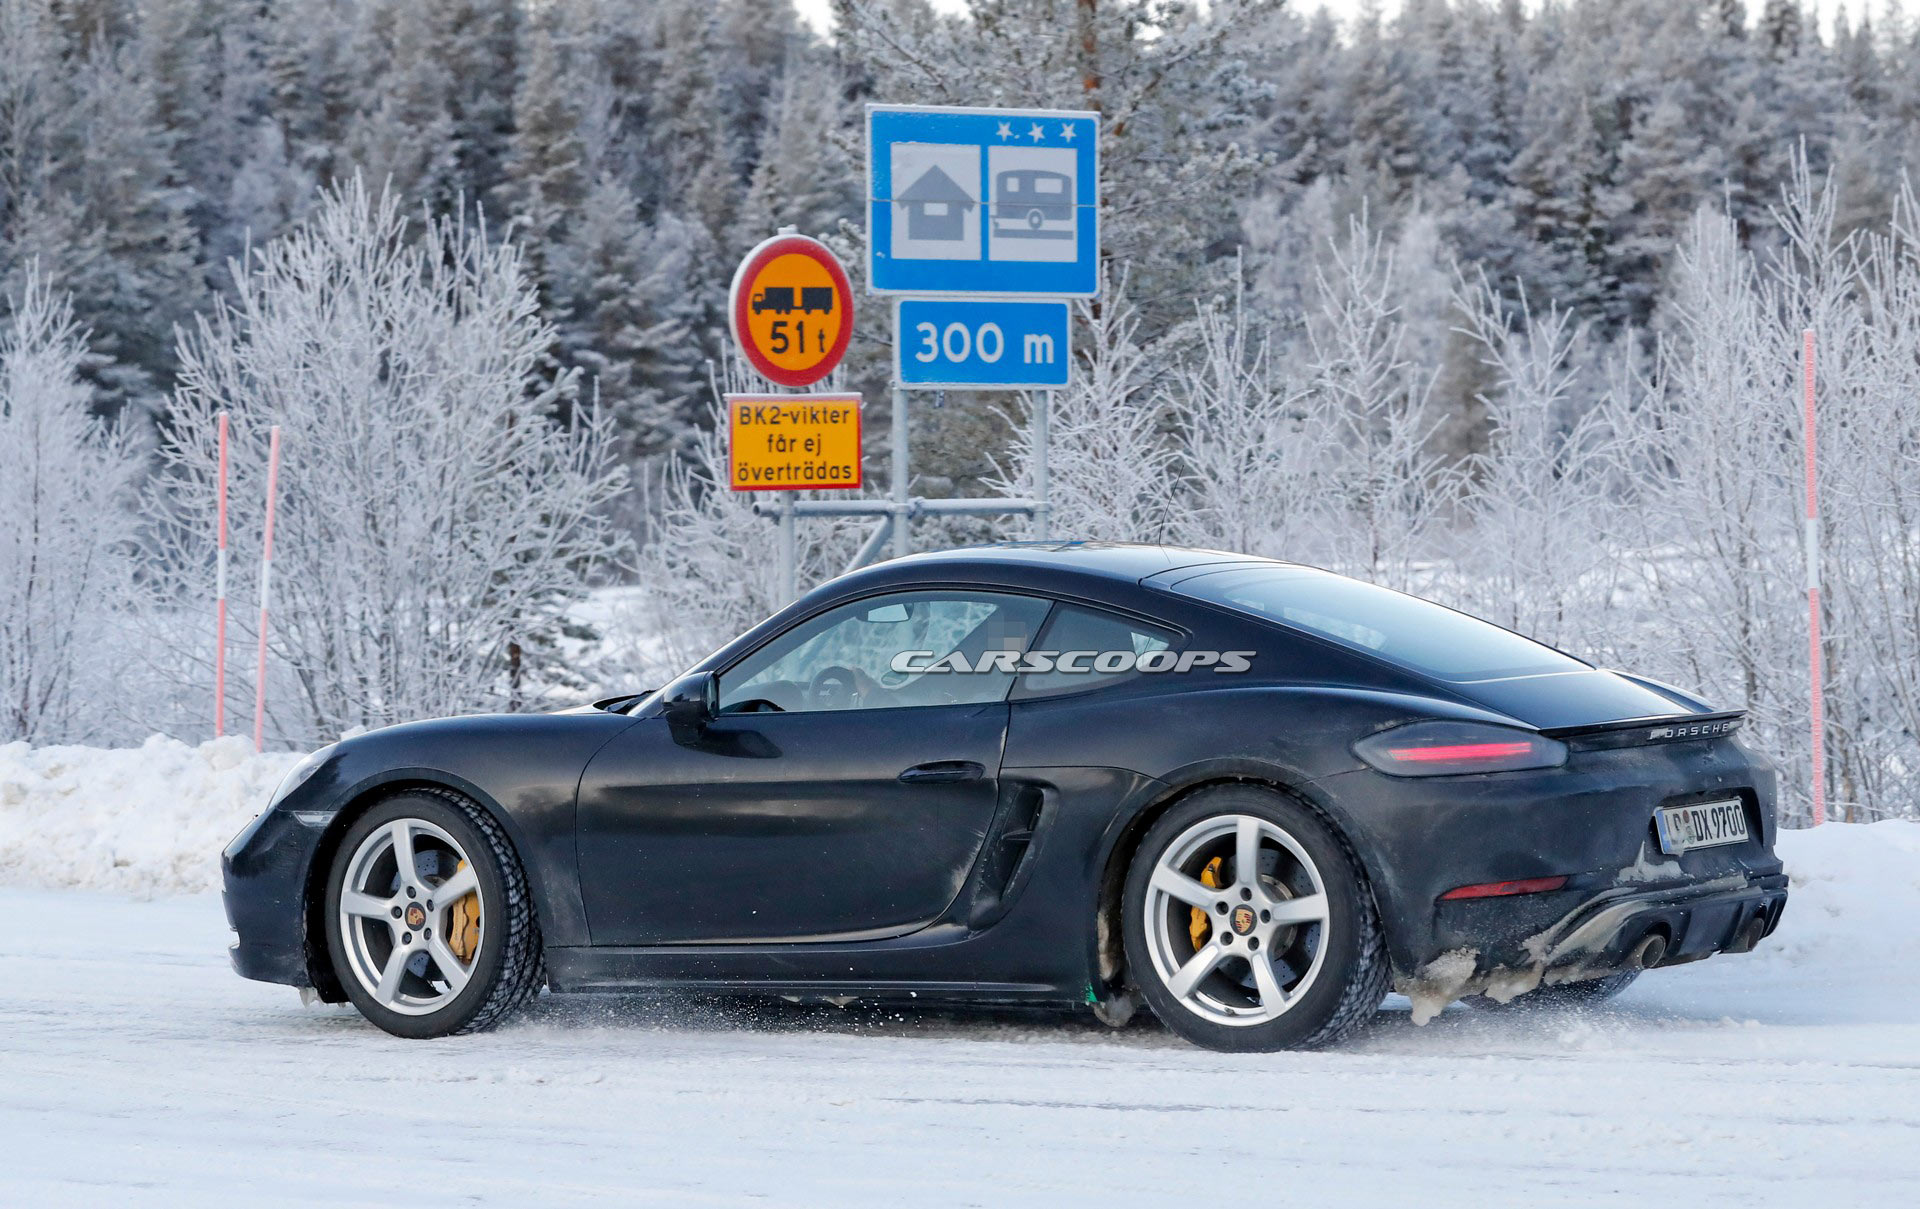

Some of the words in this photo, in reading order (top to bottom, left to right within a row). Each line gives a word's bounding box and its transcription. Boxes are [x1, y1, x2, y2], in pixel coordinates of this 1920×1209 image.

[769, 320, 805, 355] 51
[818, 328, 826, 354] t
[915, 321, 1005, 364] 300
[1023, 332, 1055, 364] m
[739, 406, 850, 425] BK2-vikter
[767, 433, 797, 453] får
[804, 433, 822, 456] ej
[738, 460, 852, 481] överträdas
[1691, 809, 1713, 842] DX
[1711, 804, 1746, 839] 9700
